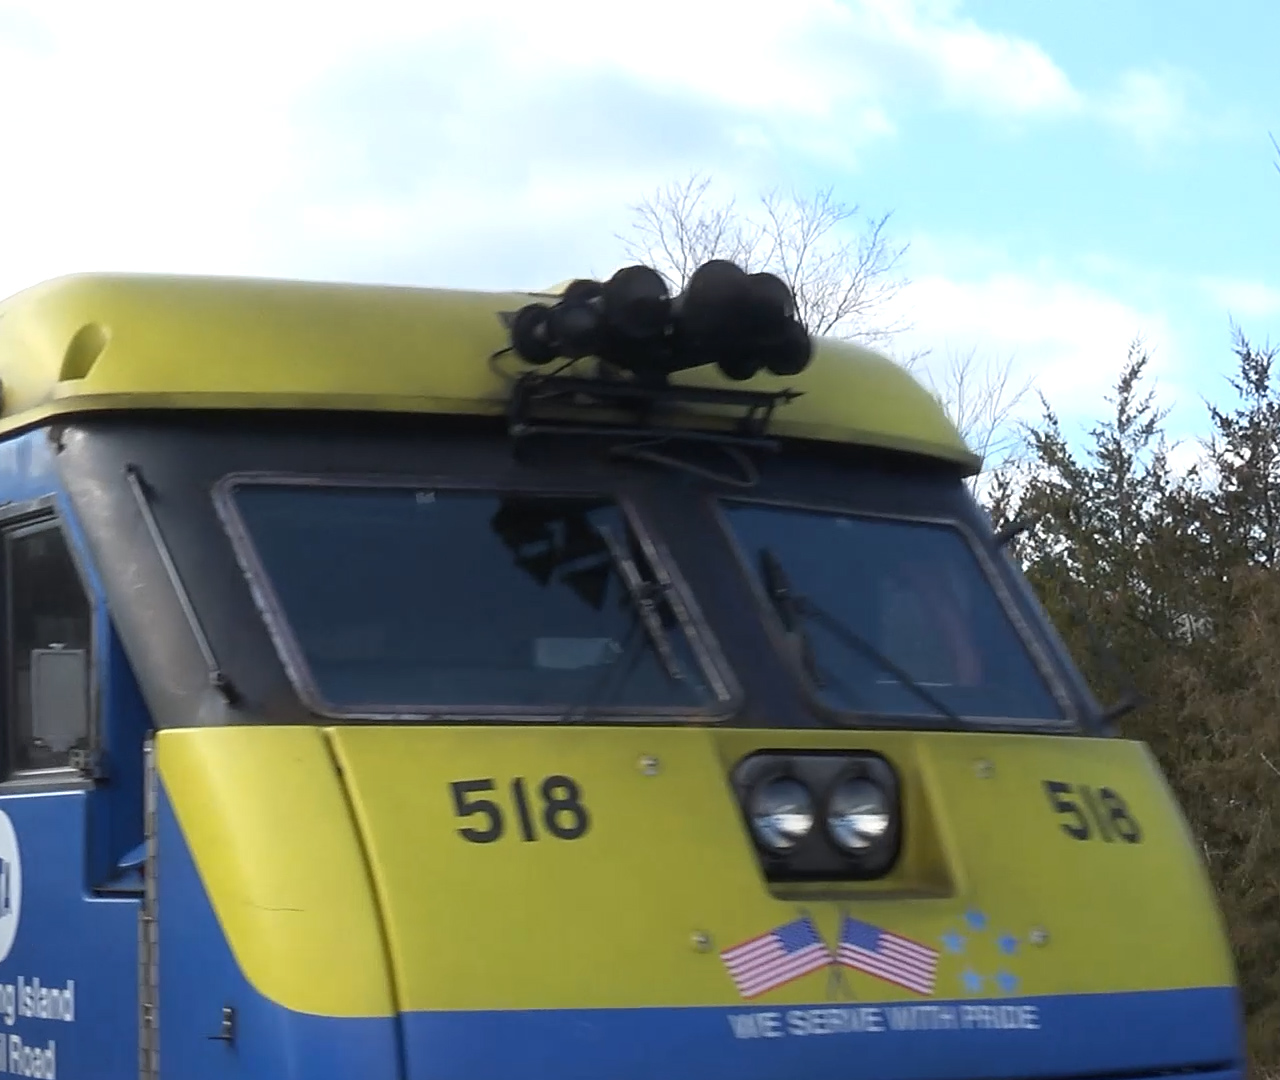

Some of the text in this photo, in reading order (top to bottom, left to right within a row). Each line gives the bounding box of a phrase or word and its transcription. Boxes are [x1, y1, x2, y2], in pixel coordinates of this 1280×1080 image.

[450, 775, 590, 843] 518
[1042, 780, 1143, 844] 518
[17, 975, 76, 1022] Island
[727, 1005, 1041, 1039] WE SERVE WITH PRIDE
[8, 1033, 57, 1080] Road
